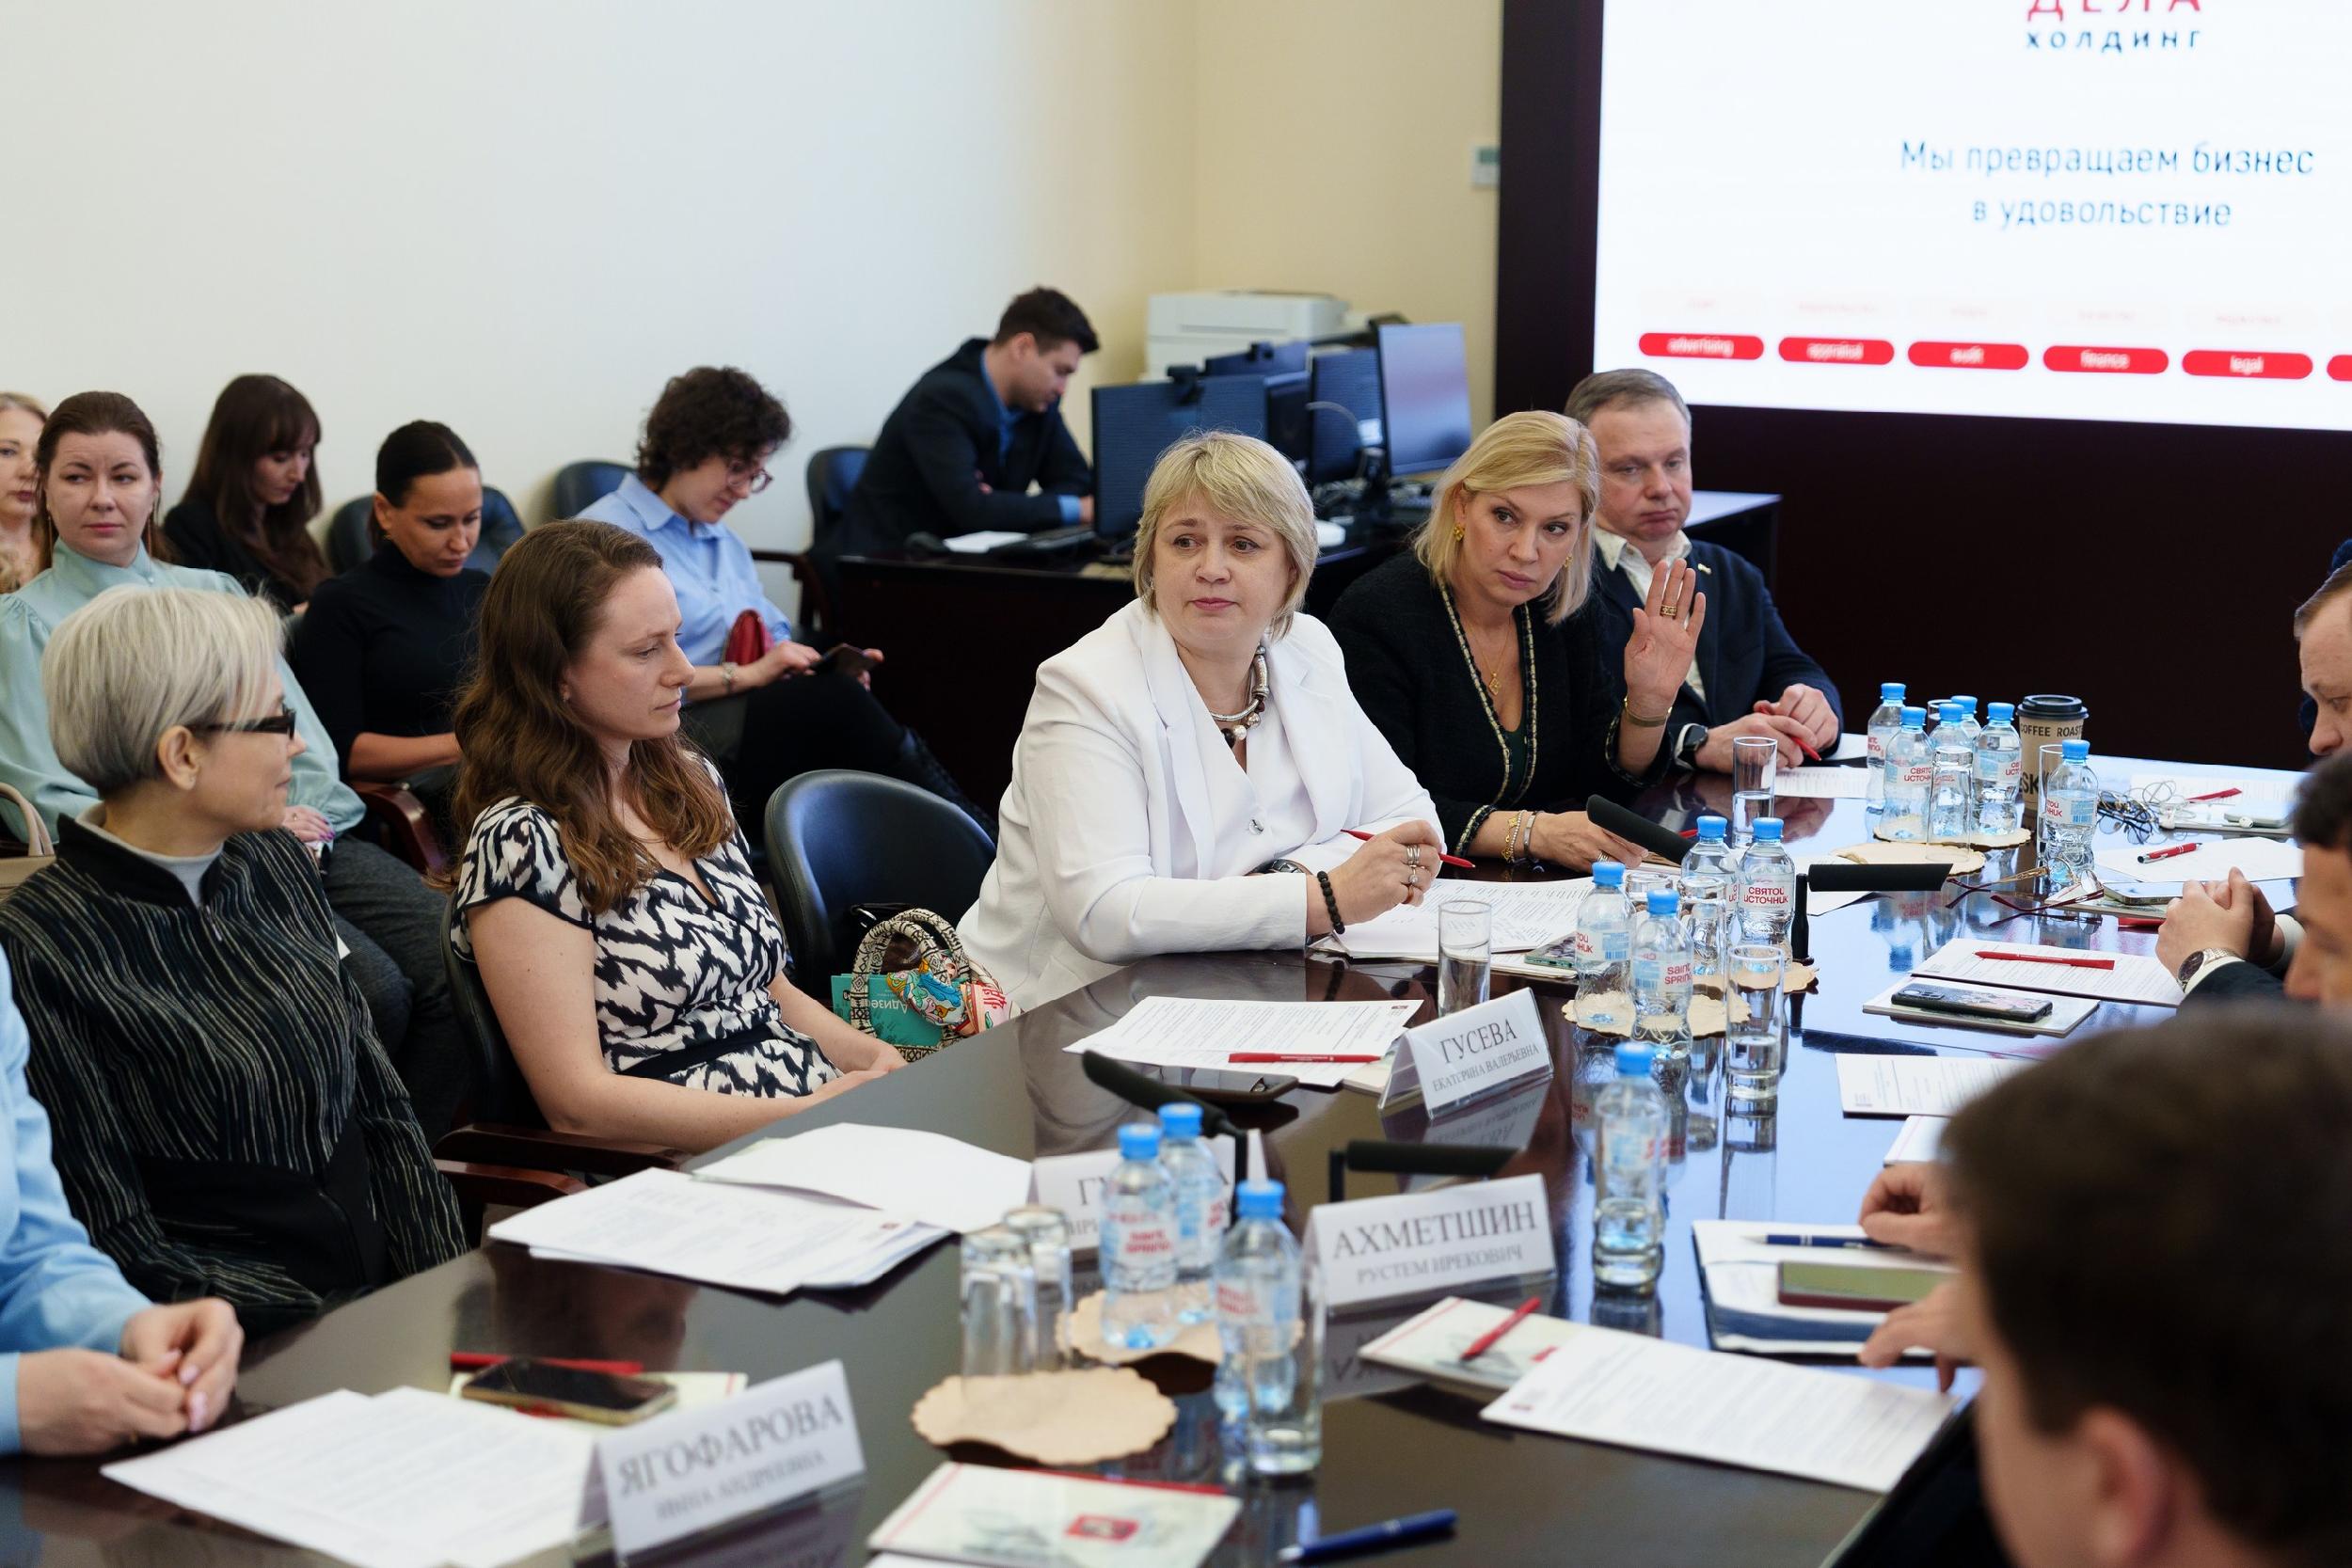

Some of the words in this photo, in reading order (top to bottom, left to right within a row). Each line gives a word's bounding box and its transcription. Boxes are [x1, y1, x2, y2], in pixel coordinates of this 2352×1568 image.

[2026, 30, 2201, 53] холдинг
[1901, 141, 1954, 170] Мы
[1967, 147, 2178, 177] превращаем
[2192, 141, 2315, 175] бизнес
[1973, 200, 1987, 222] в
[2000, 199, 2232, 231] удовольствие
[1440, 1018, 1518, 1065] ГУСЕВА
[1432, 1063, 1486, 1093] ЕКАТЕРИНА
[1486, 1042, 1540, 1074] ВАЛЕРЬЕВНА
[1333, 1200, 1538, 1260] АХМЕТШИН
[1357, 1258, 1432, 1285] РУСТЕМ
[1432, 1244, 1524, 1275] ИРЕКОВИЧ
[618, 1393, 844, 1499] ЯГОФАРОВА
